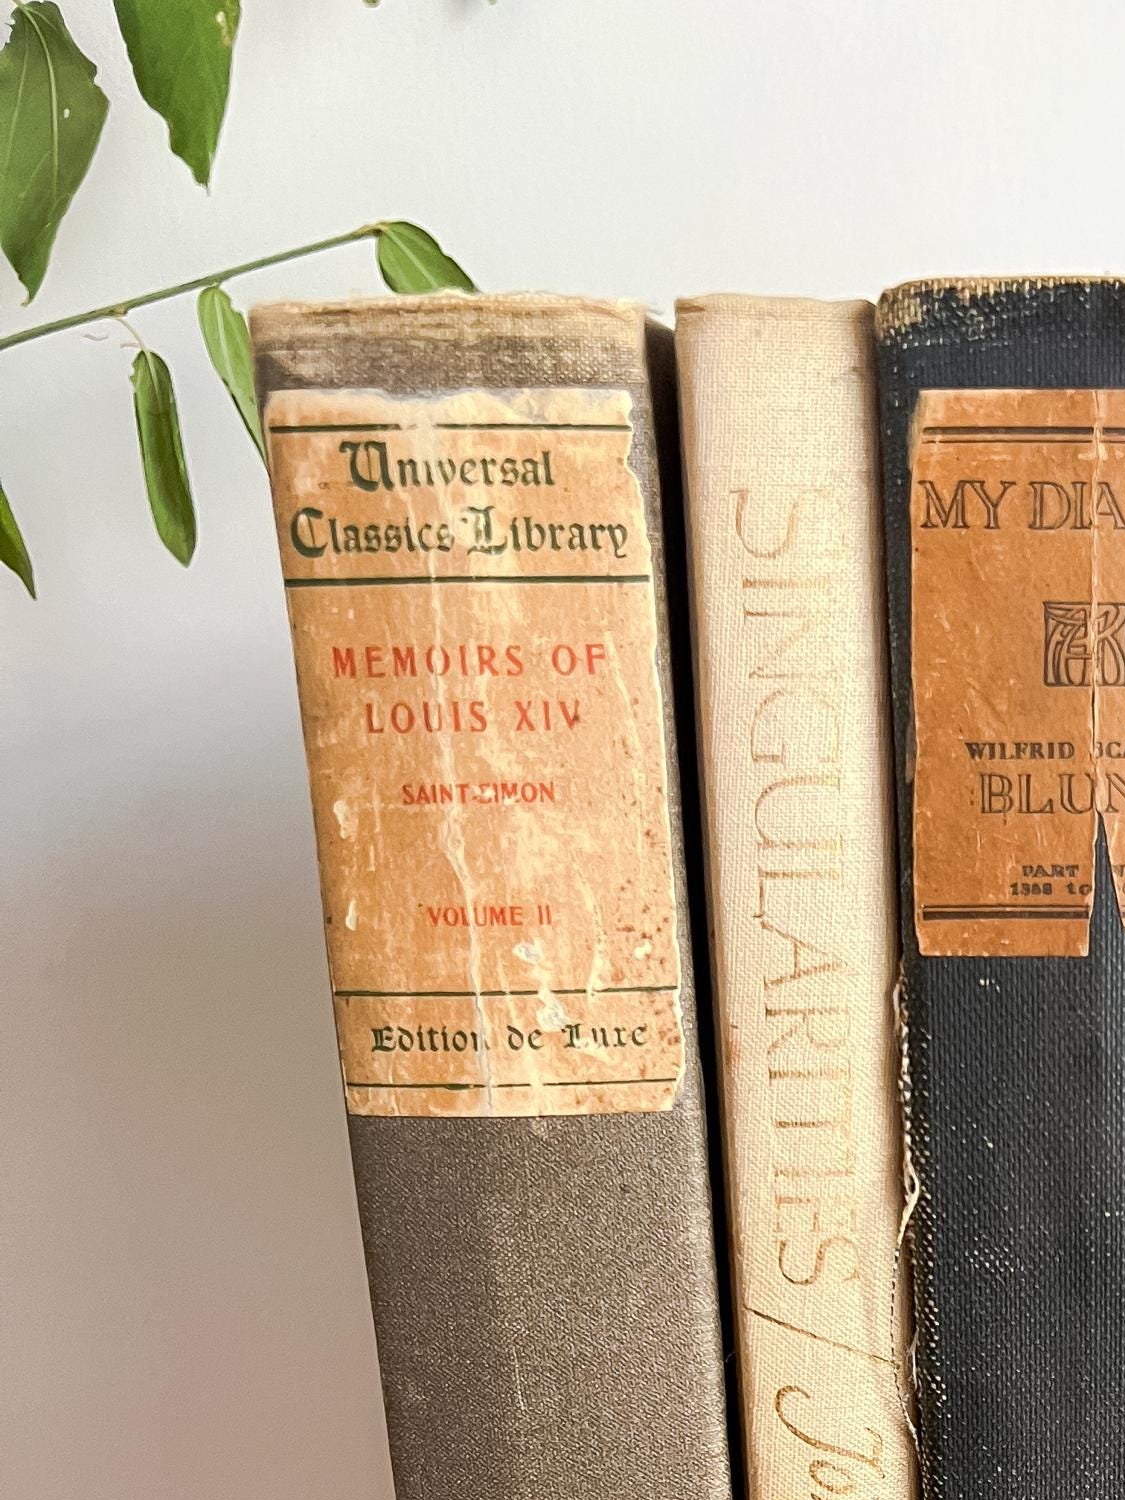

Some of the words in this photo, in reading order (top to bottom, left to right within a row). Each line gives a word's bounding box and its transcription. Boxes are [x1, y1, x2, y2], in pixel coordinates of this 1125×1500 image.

[339, 440, 555, 491] Universal
[918, 480, 1016, 530] MY
[290, 507, 455, 558] Classics
[461, 505, 628, 559] Library
[332, 644, 524, 679] MEMOIRS
[551, 644, 606, 676] OF
[366, 701, 488, 733] LOUIS
[515, 700, 581, 731] XIV
[964, 741, 1075, 761] WILFRID
[729, 488, 862, 1287] SINGULARITIES
[1022, 864, 1080, 878] PART
[427, 905, 523, 928] VOLUME
[537, 904, 552, 927] II
[507, 1025, 544, 1050] de
